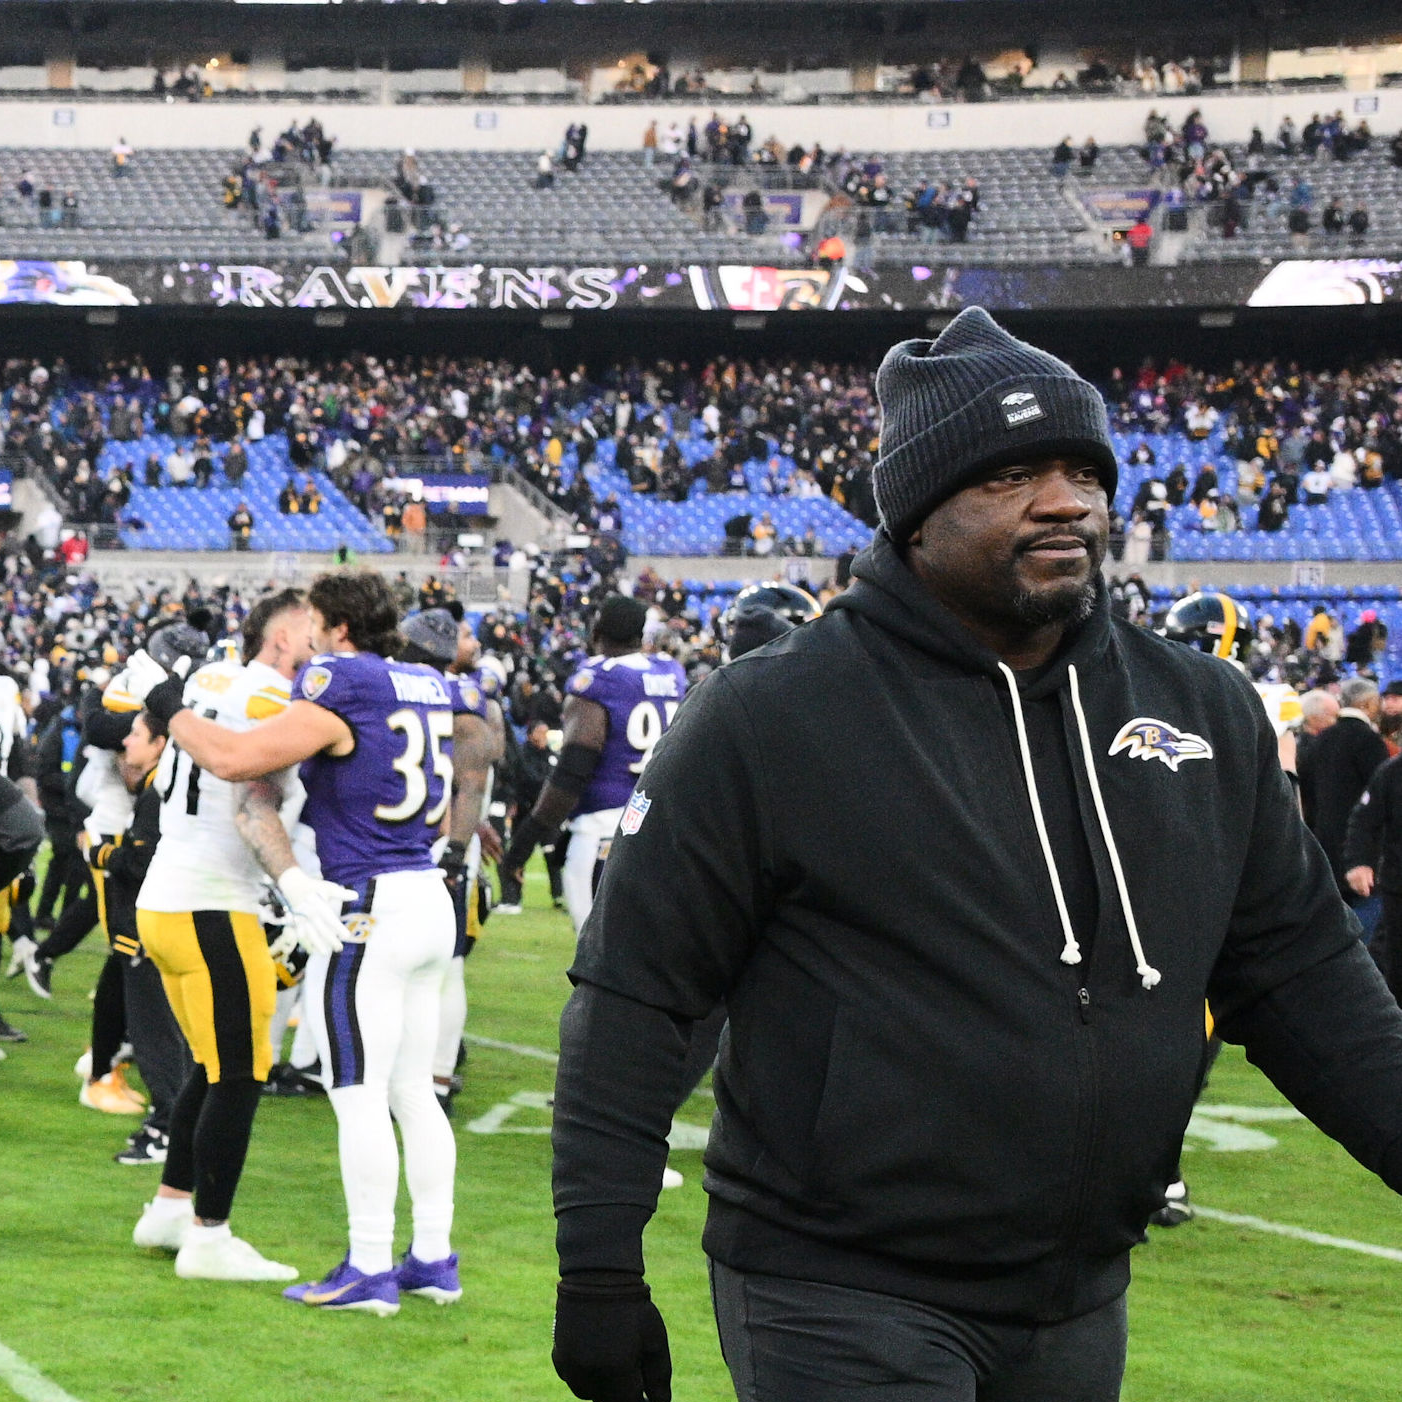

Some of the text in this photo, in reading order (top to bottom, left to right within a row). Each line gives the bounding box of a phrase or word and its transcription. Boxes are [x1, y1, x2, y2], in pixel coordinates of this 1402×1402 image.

[217, 265, 618, 310] RAVENS
[373, 709, 454, 825] 35
[625, 807, 639, 830] NFL
